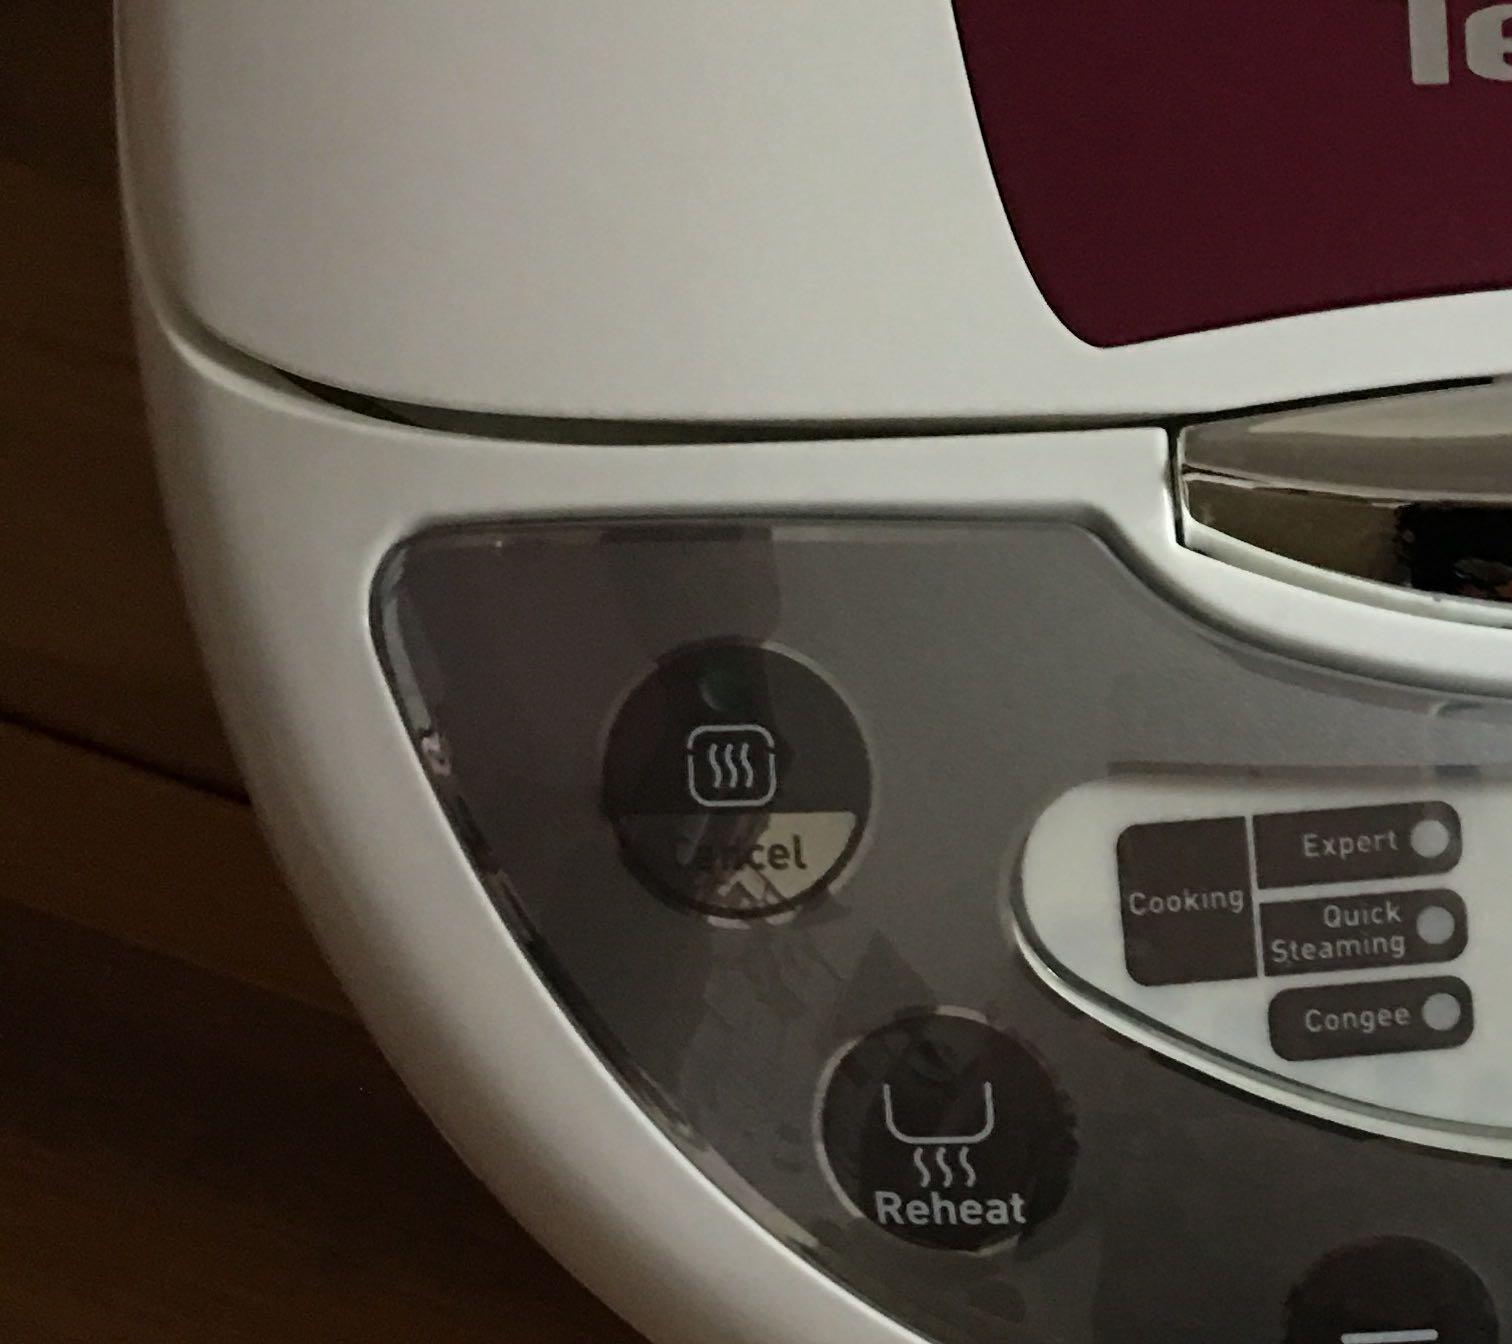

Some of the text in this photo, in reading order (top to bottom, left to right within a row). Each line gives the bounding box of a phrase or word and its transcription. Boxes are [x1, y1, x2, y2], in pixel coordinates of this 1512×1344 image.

[1302, 828, 1399, 860] Expert
[1127, 887, 1245, 916] Cooking
[1322, 900, 1402, 929] Quick
[1271, 933, 1406, 964] Steaming
[1304, 1005, 1412, 1035] Congee
[874, 1189, 1027, 1226] Reheat
